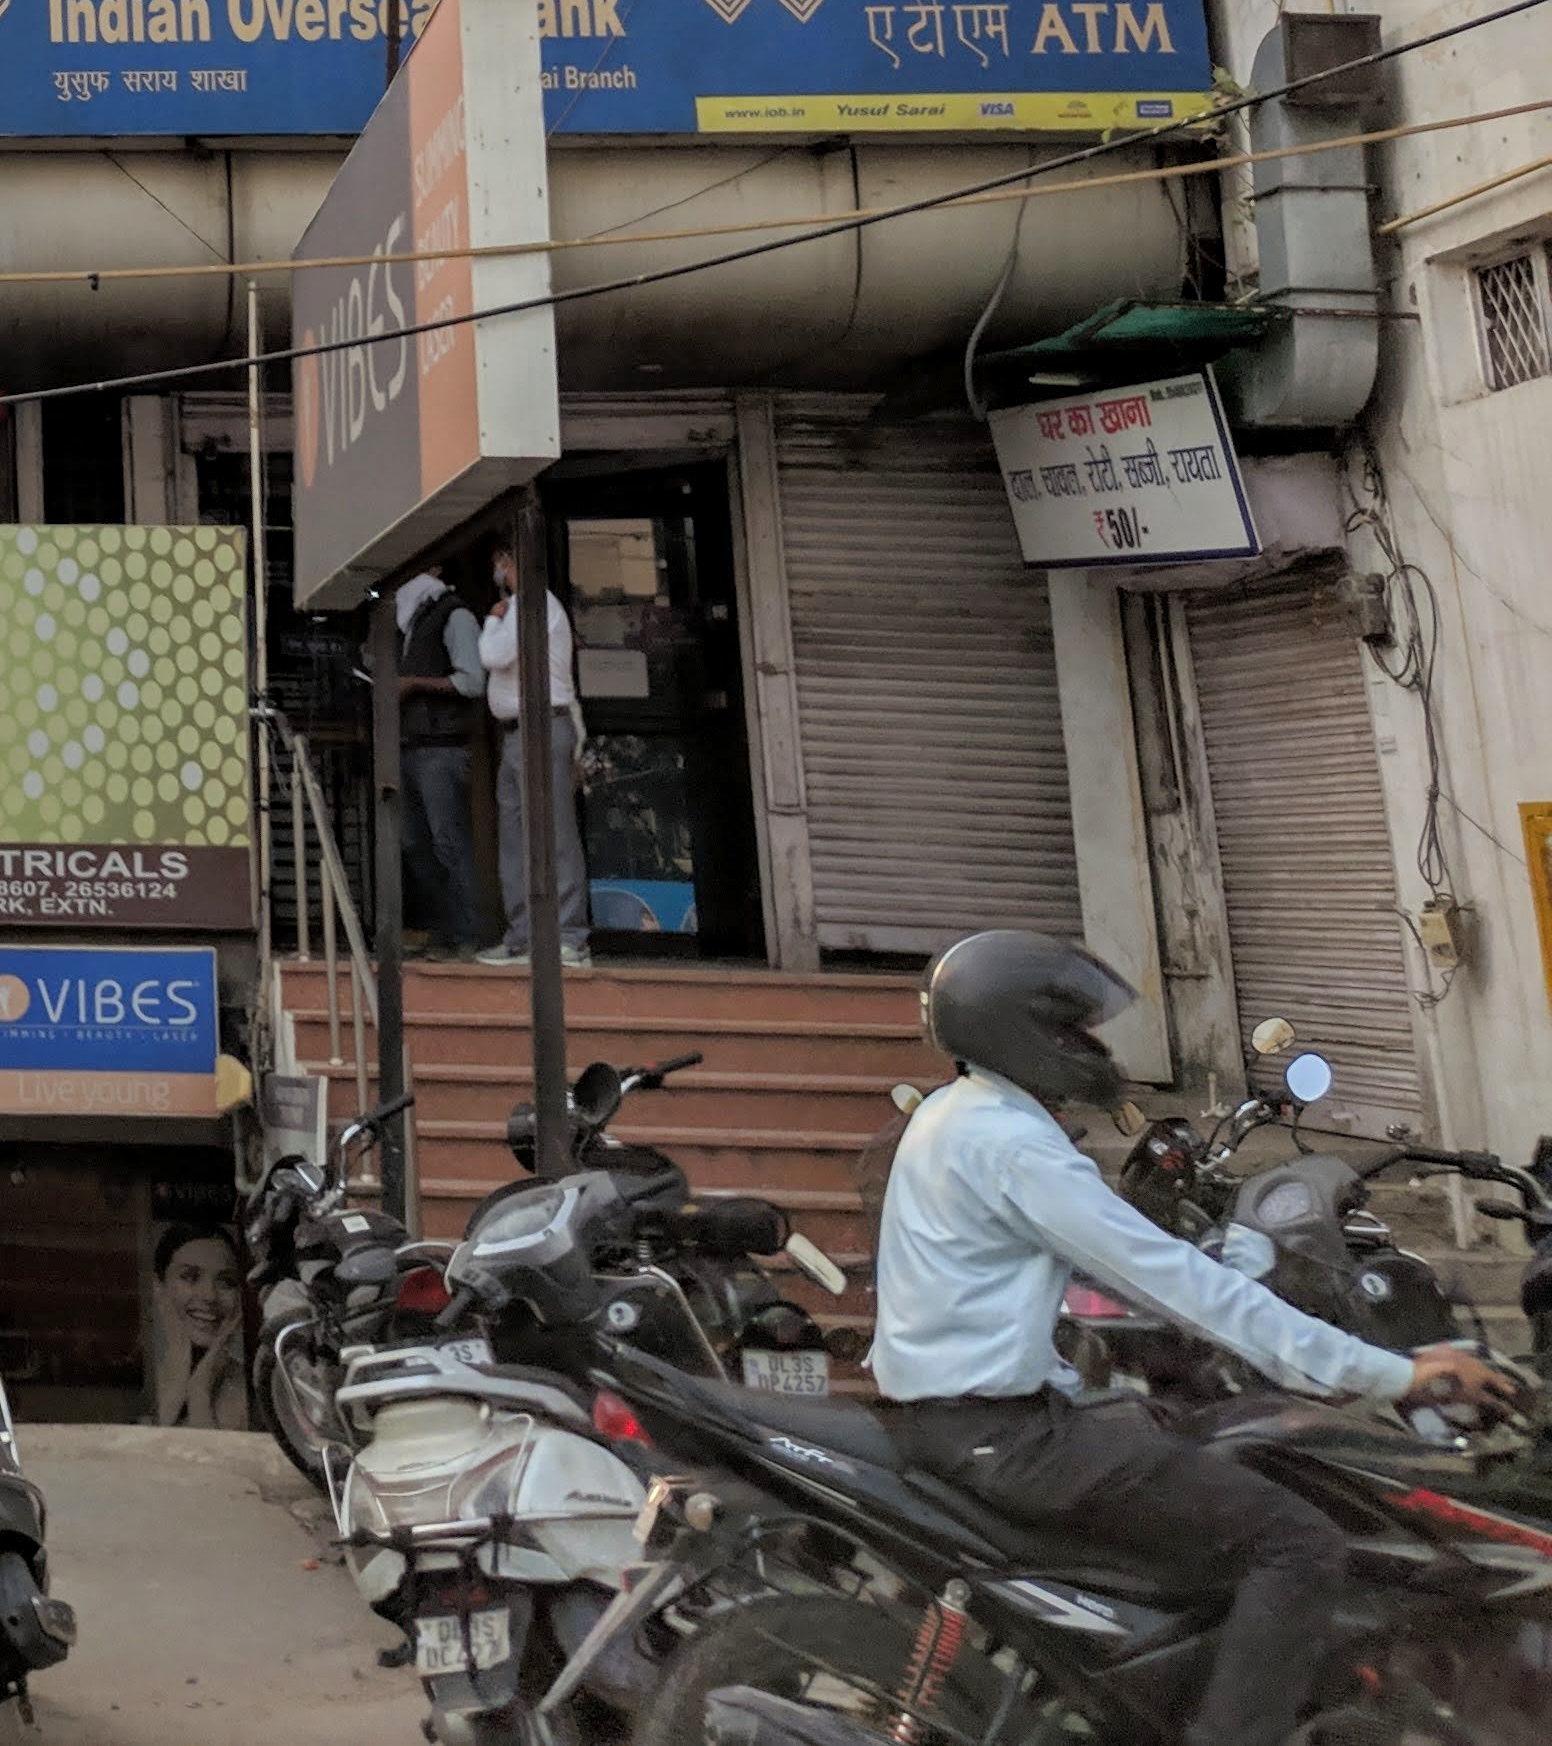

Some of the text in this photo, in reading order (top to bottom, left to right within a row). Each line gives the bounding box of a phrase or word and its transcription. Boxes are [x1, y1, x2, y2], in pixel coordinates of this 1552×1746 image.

[1031, 2, 1176, 55] ATM
[122, 70, 178, 94] सराय
[190, 69, 248, 94] शाखा
[565, 66, 637, 91] Branch
[836, 103, 946, 118] Yusuf Sarai
[979, 104, 1015, 117] VISA
[1067, 404, 1096, 437] का
[1097, 396, 1153, 435] खाना
[65, 880, 176, 900] 26536124
[40, 897, 114, 917] EXTN.
[36, 978, 198, 1025] VIBES
[17, 1071, 171, 1111] Live young
